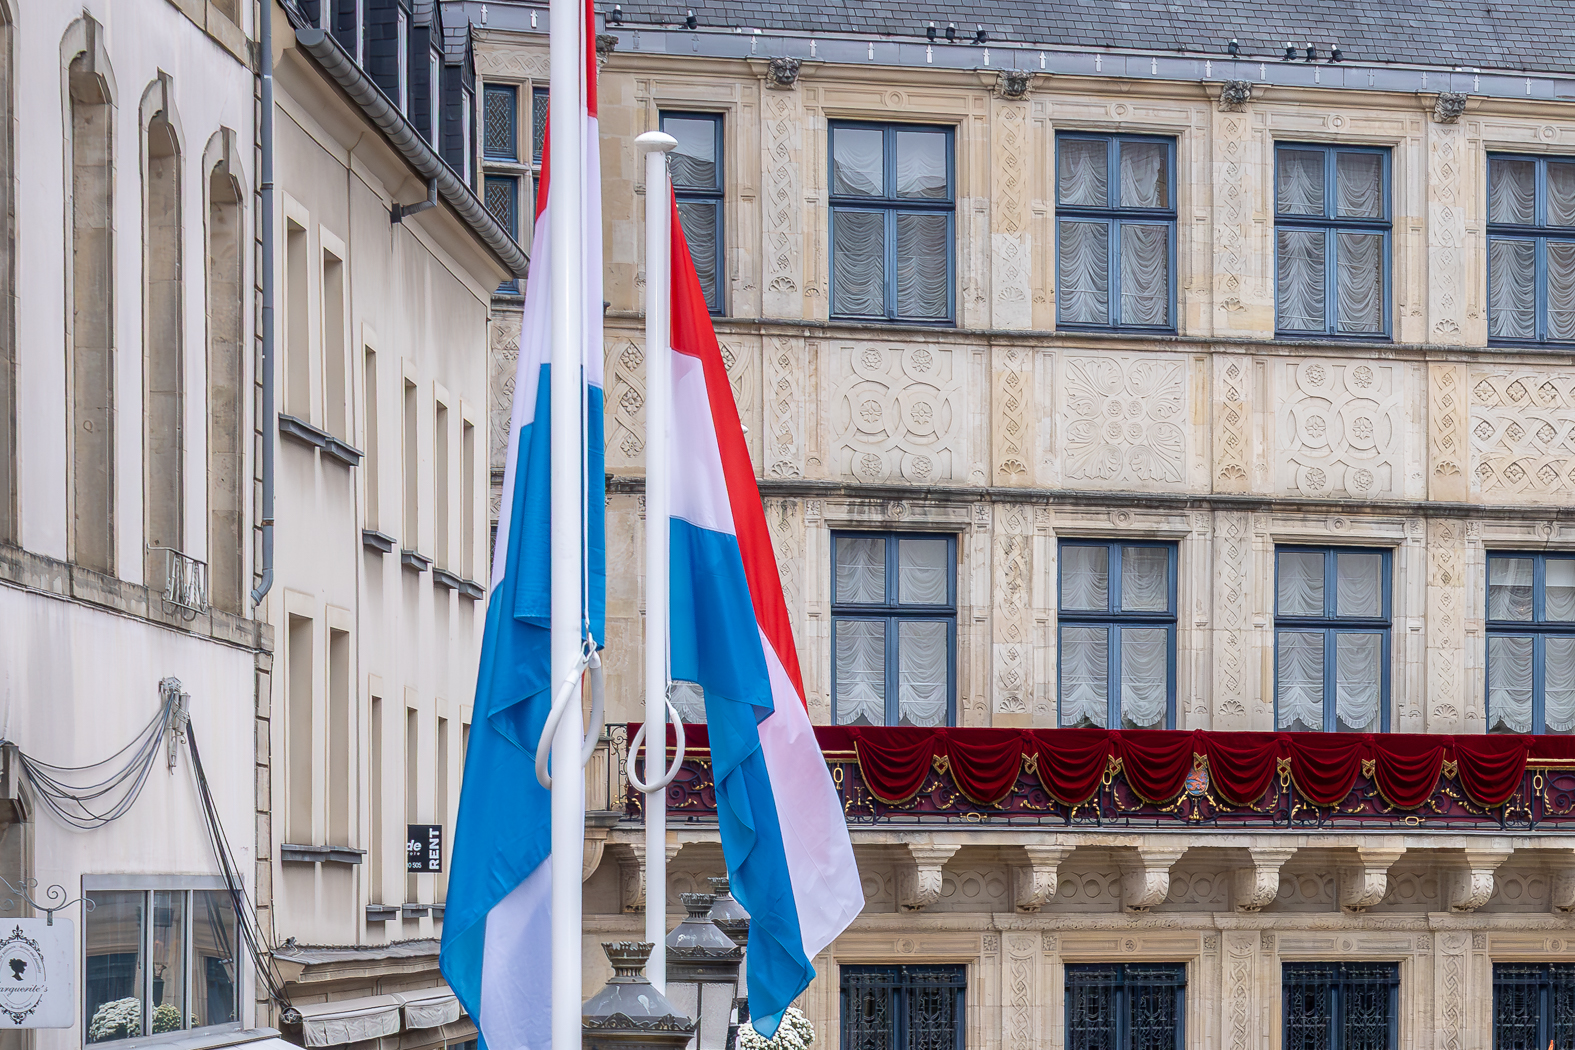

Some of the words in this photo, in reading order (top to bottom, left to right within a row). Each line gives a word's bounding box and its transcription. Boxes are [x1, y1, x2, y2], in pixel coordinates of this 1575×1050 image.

[407, 839, 422, 851] de
[429, 828, 440, 869] RENT
[0, 984, 49, 997] arguerite's
